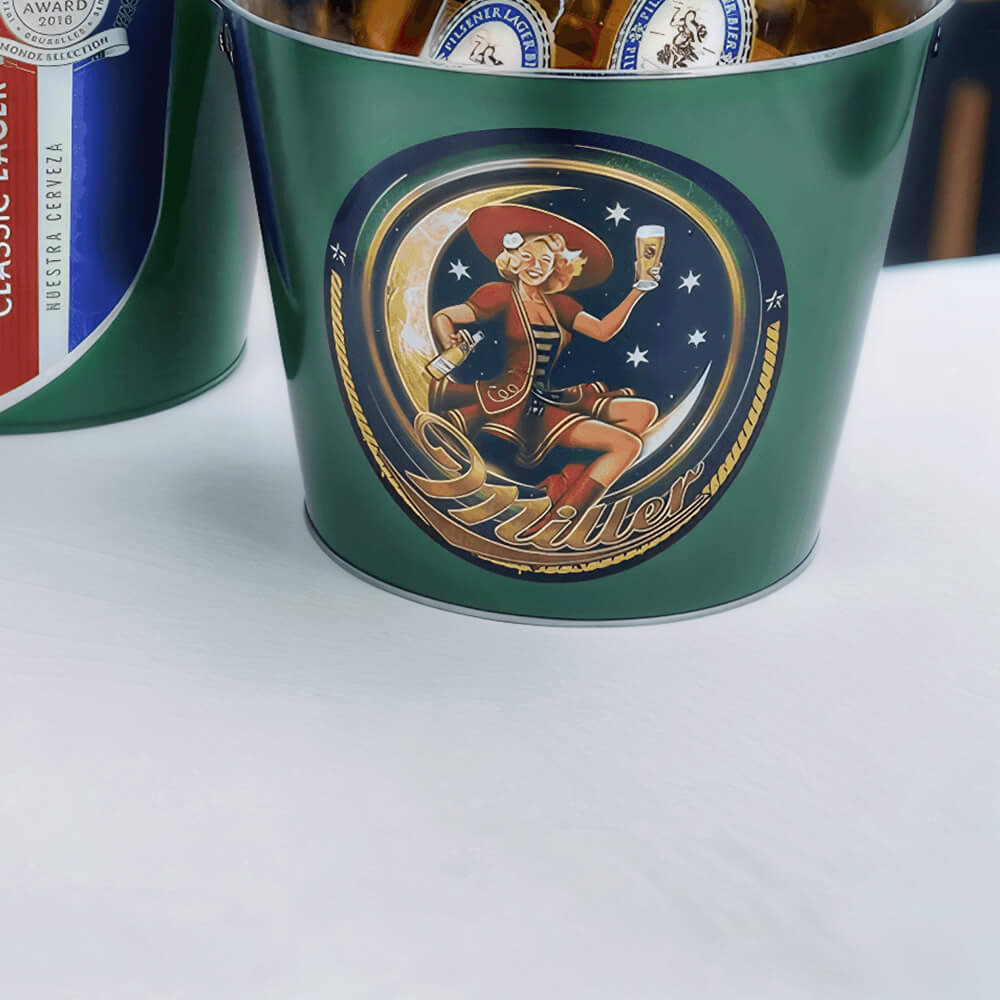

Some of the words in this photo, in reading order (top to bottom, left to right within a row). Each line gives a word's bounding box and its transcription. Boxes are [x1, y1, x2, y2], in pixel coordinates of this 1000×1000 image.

[22, 0, 88, 14] AWARD
[444, 6, 502, 51] PILSENER
[45, 142, 63, 221] CERVEZA
[46, 232, 63, 311] NUESTRA
[404, 410, 706, 551] Miller
